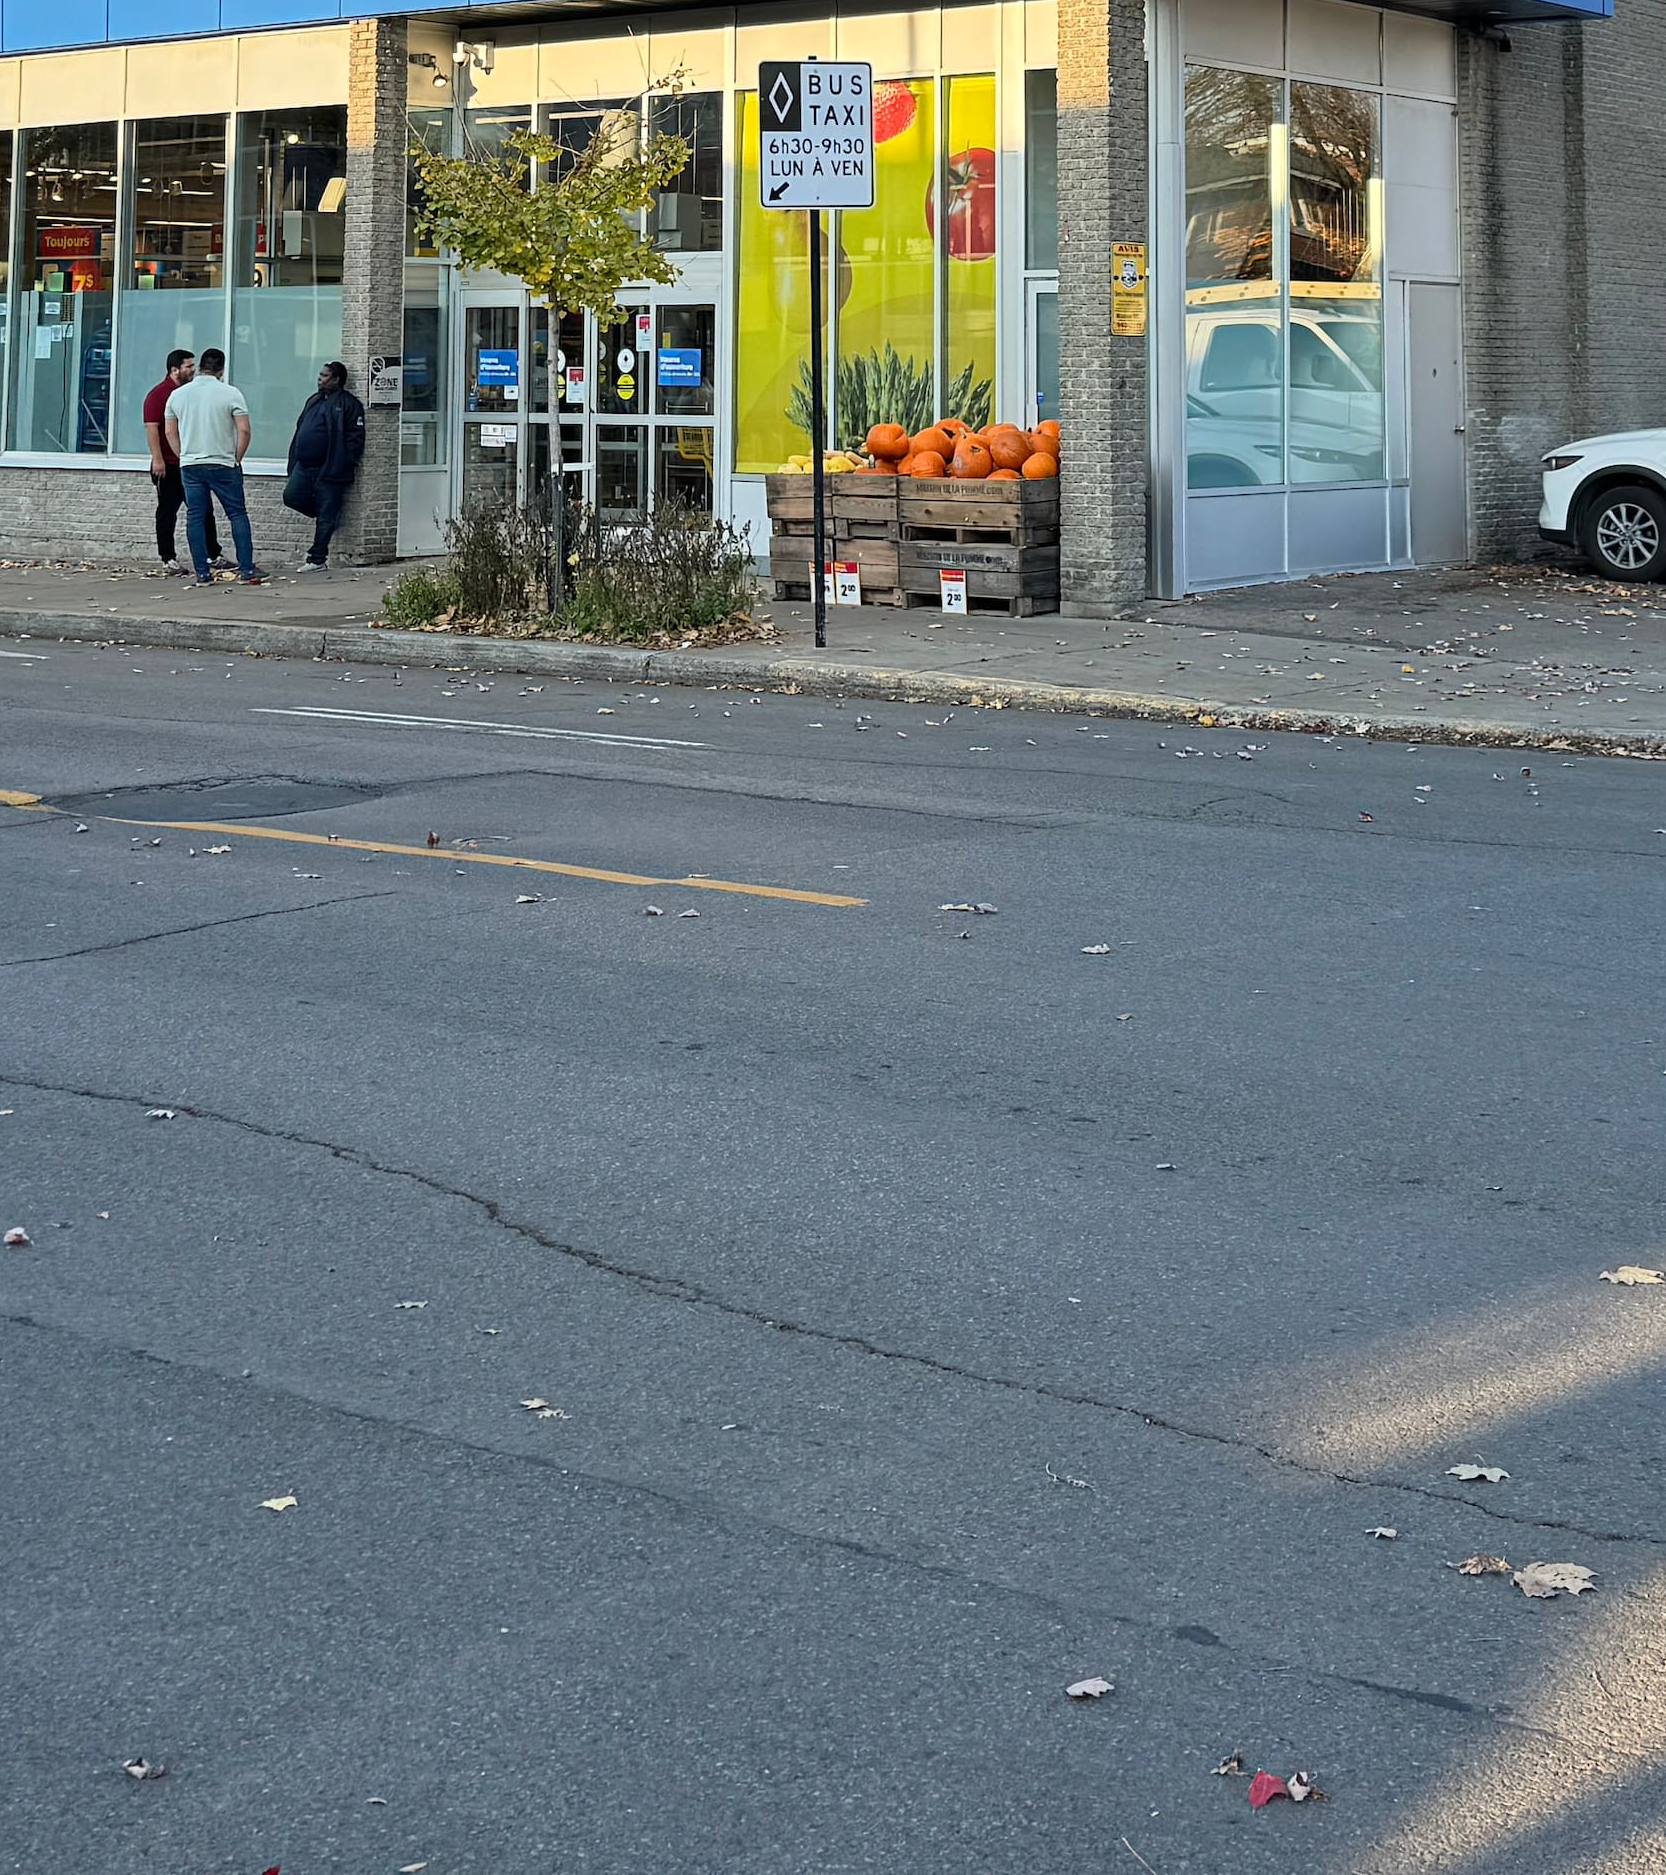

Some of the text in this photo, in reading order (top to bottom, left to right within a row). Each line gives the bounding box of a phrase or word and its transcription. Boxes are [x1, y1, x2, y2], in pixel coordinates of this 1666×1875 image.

[809, 74, 863, 95] BUS
[809, 105, 864, 126] TAXI
[769, 138, 865, 155] 6h30-9h30
[771, 157, 864, 176] LUN À VEN
[45, 235, 90, 249] Toujours
[374, 377, 399, 387] ZONE
